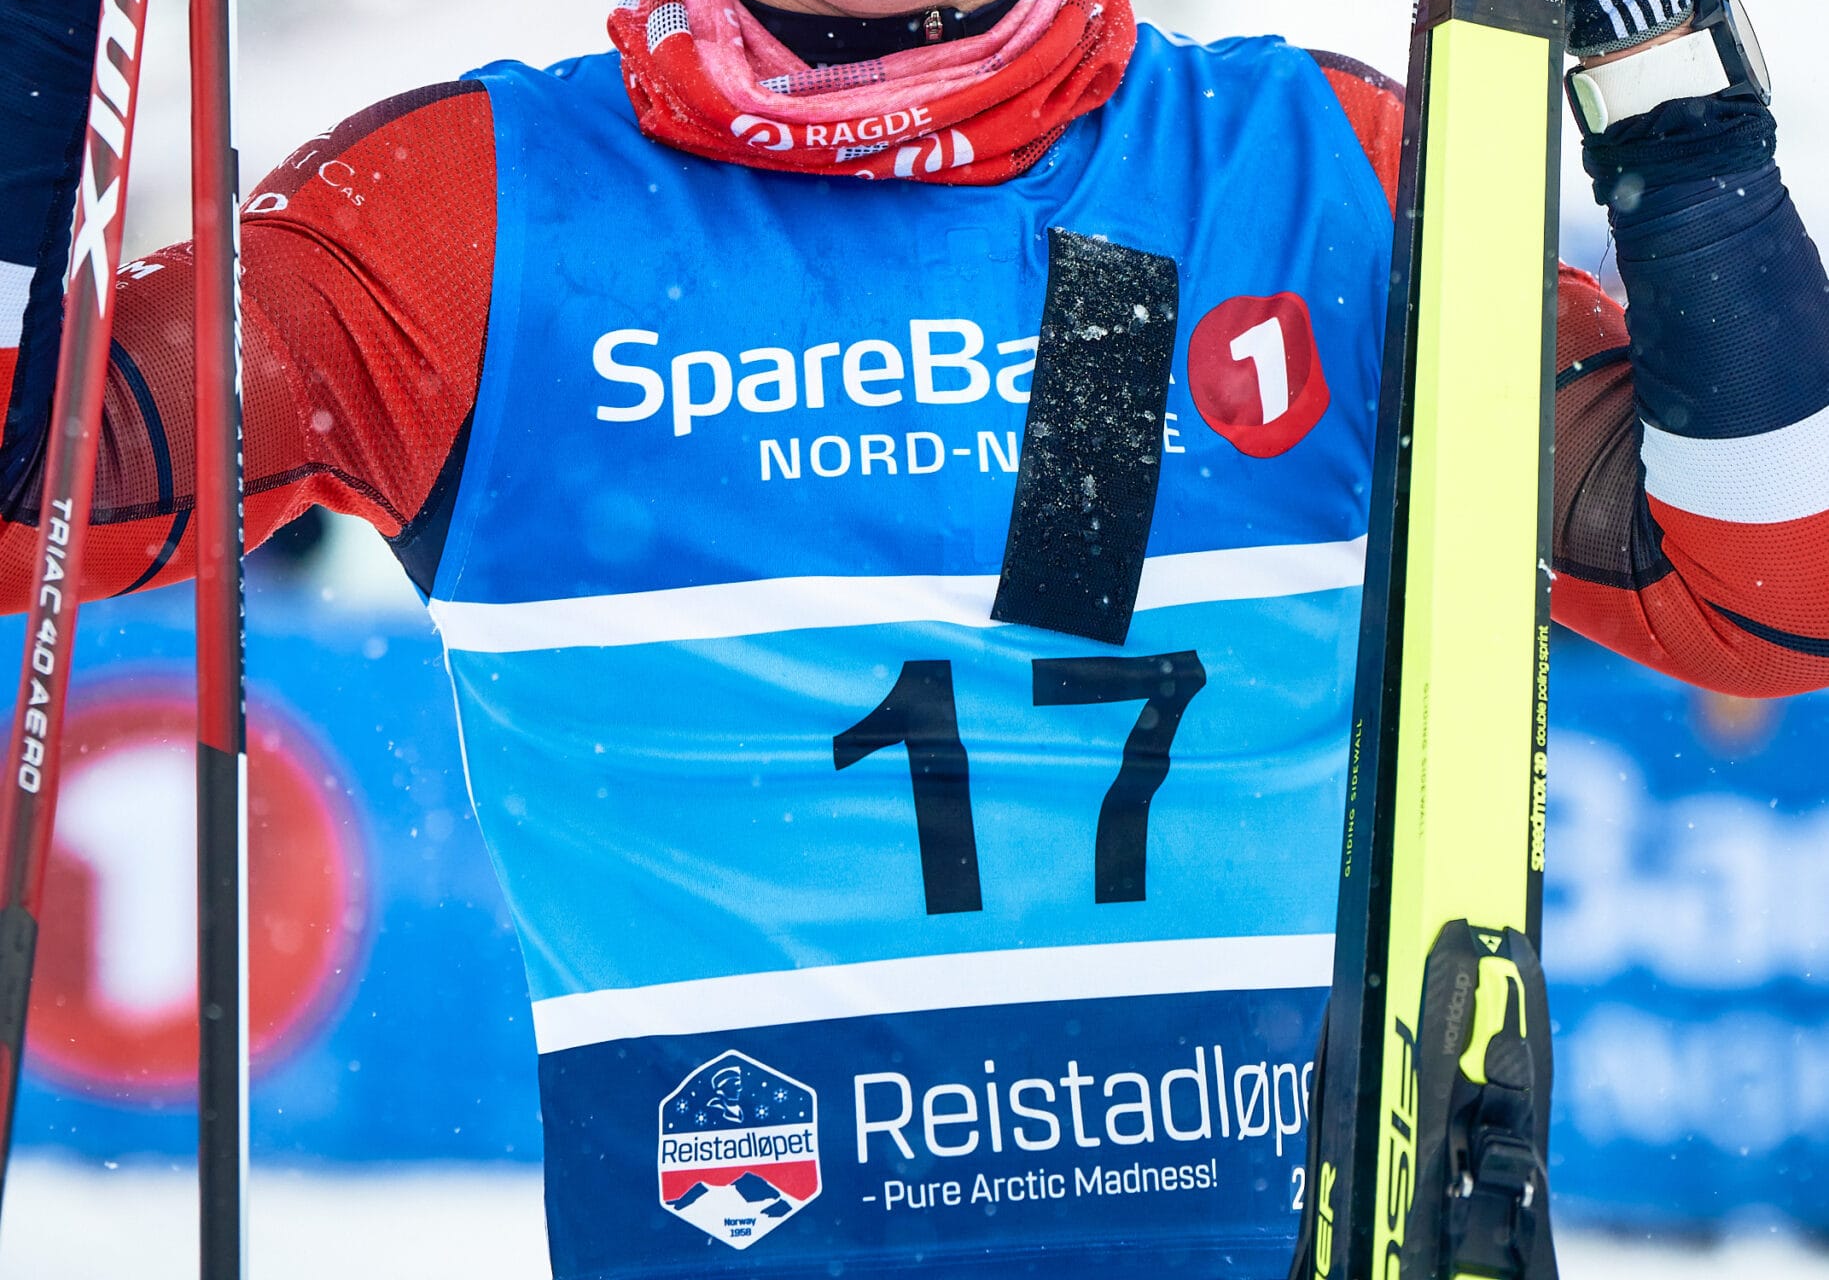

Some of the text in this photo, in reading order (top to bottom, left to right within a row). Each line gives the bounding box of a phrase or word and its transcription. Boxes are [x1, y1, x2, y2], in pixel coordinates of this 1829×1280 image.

[806, 107, 933, 147] RAGDE
[591, 316, 1290, 438] SpareBa 1
[40, 498, 72, 615] TRIAC
[1538, 625, 1549, 661] sprint
[1536, 661, 1549, 701] poling
[18, 676, 50, 795] AERO
[1536, 701, 1547, 747] double
[832, 650, 1206, 915] 17
[1343, 717, 1363, 878] GLIDING SIDEWALL
[661, 1129, 815, 1164] Reistadløpet
[885, 1175, 961, 1211] Pure
[971, 1169, 1067, 1203] Arctic
[1075, 1158, 1219, 1198] Madness!
[724, 1217, 756, 1226] Norway
[730, 1228, 752, 1238] 1958
